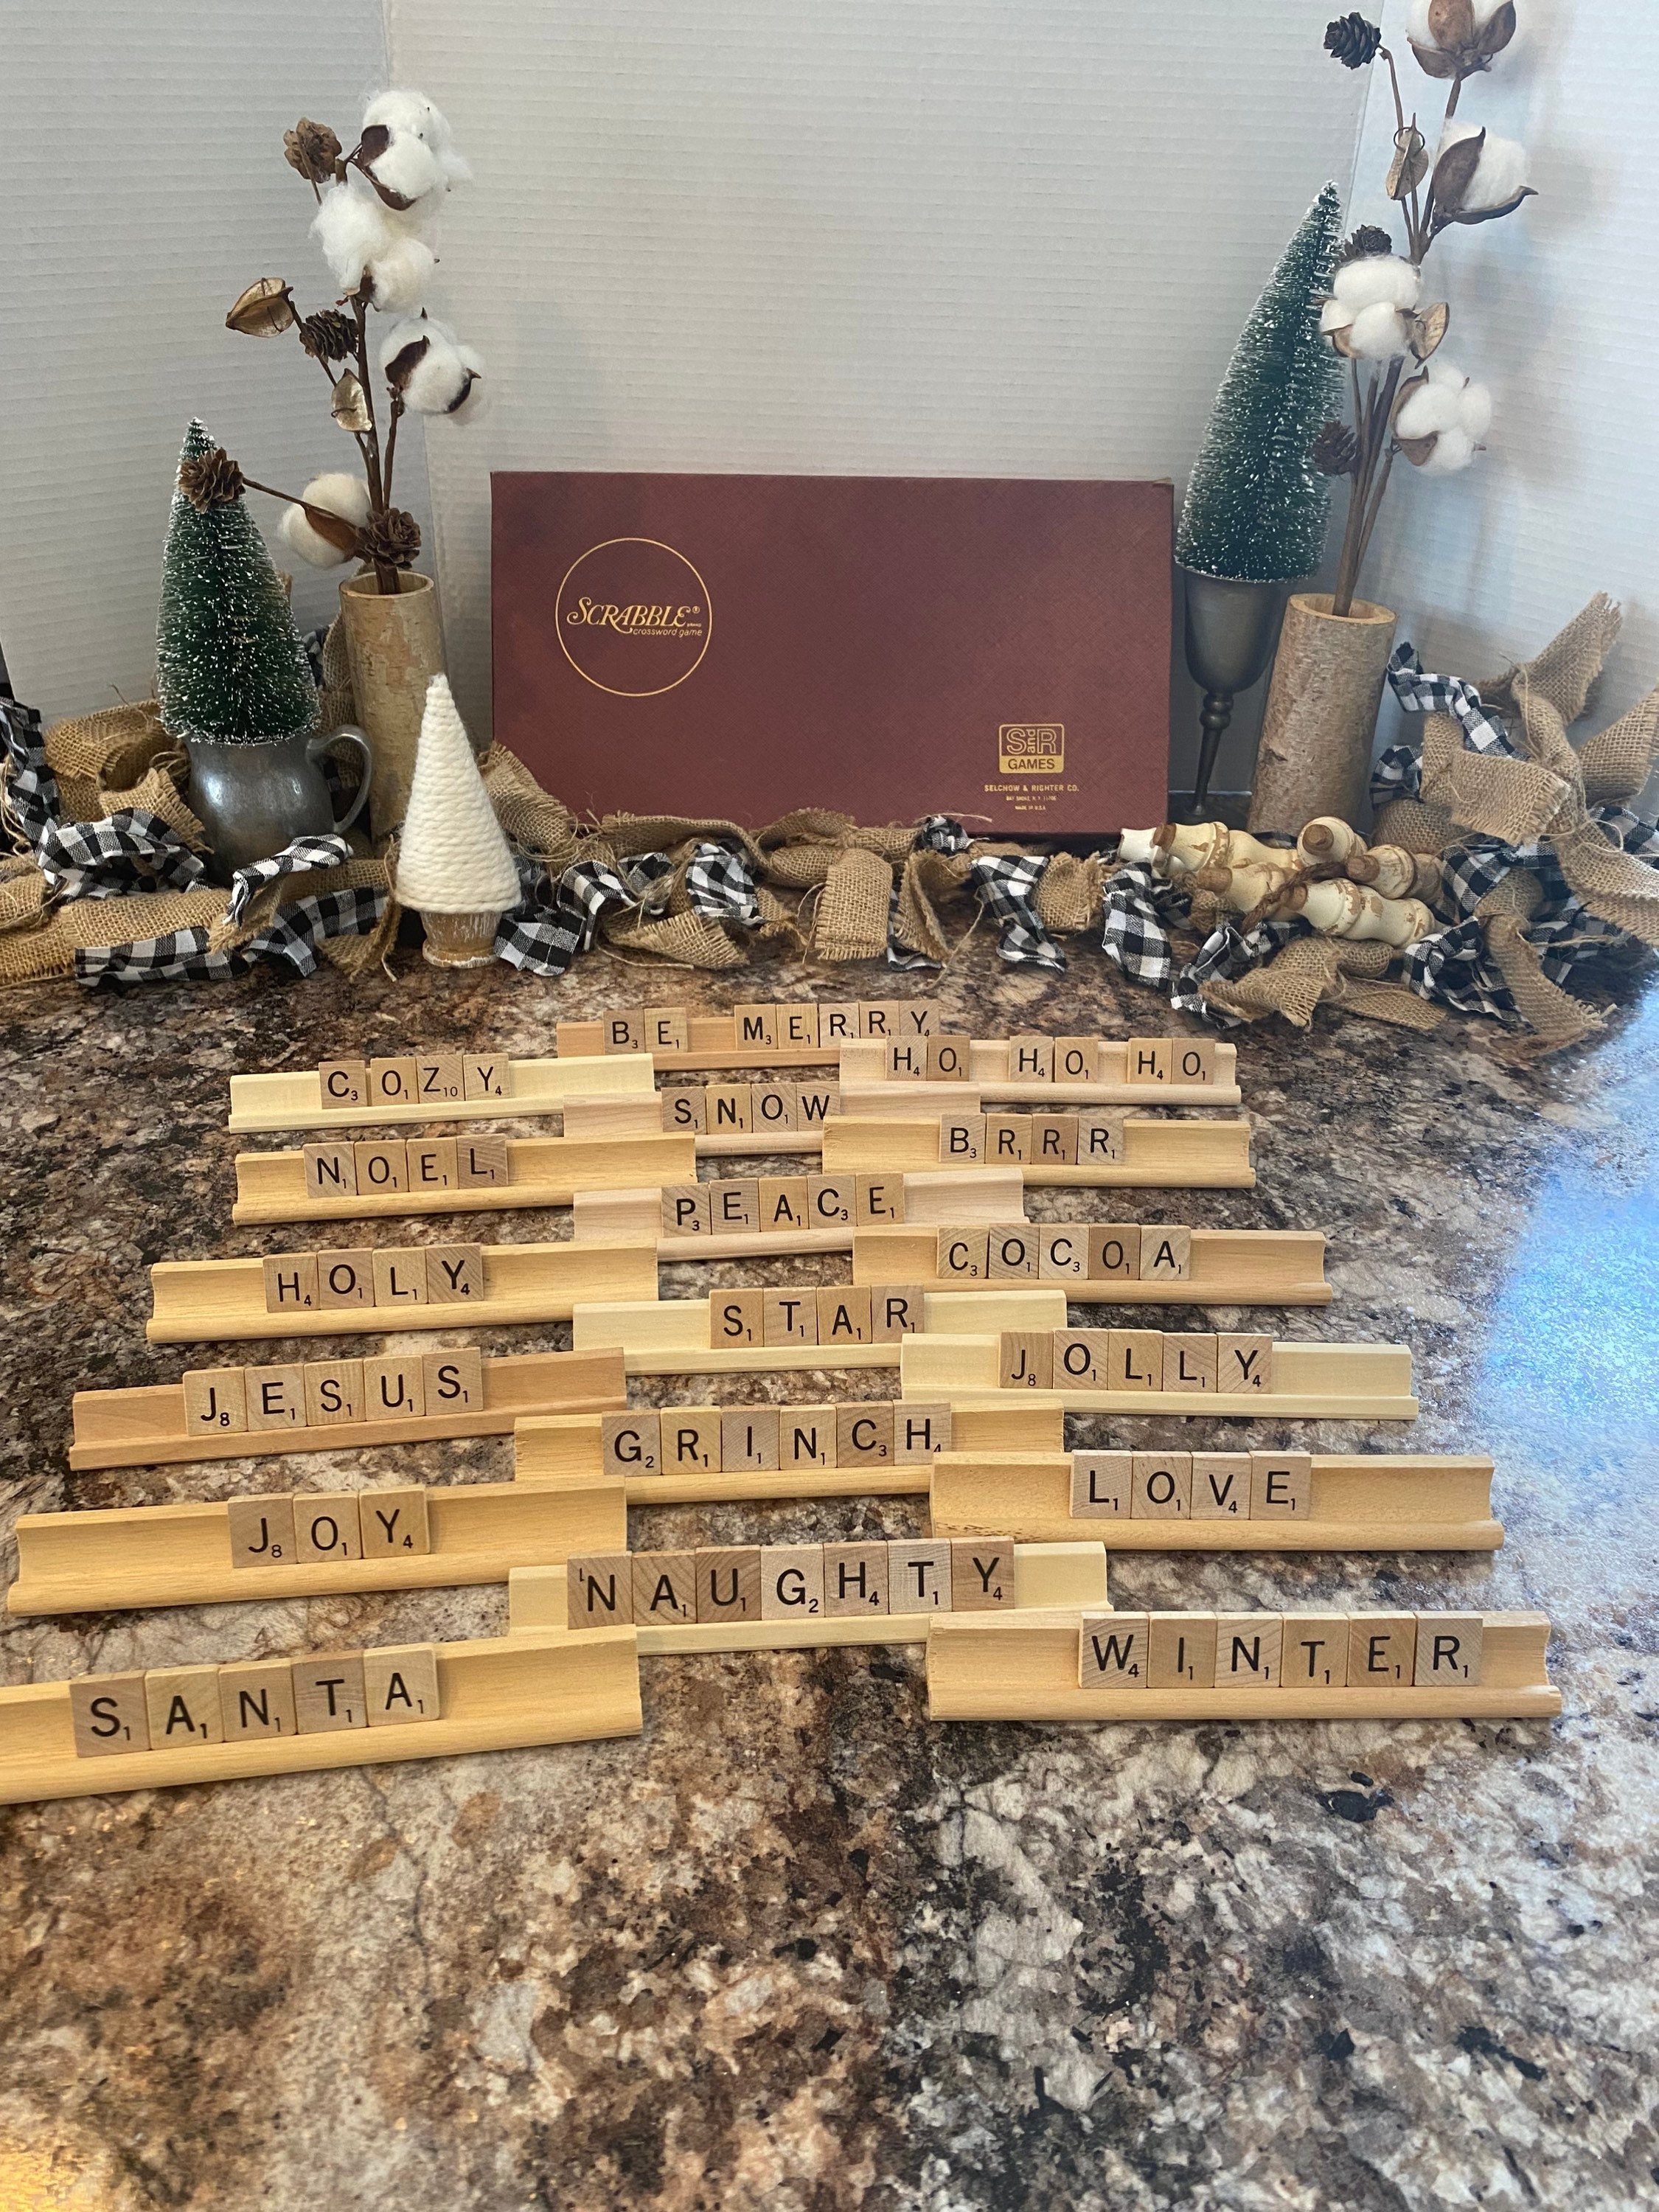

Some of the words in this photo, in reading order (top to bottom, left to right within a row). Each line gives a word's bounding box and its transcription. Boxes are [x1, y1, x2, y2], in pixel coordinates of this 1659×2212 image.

[633, 627, 678, 636] crossword
[678, 629, 703, 638] game
[1008, 758, 1055, 770] GAMES
[612, 1020, 672, 1045] BE
[743, 1010, 928, 1041] MERRY
[893, 1046, 957, 1073] HO
[1018, 1048, 1084, 1075] HO
[1138, 1050, 1201, 1077] HO
[327, 1066, 494, 1098] COZY
[674, 1093, 830, 1124] SNOW
[950, 1127, 1110, 1155] BRRR
[316, 1147, 488, 1185] NOEL
[675, 1186, 886, 1226] PEACE
[948, 1238, 1176, 1271] COCOA
[277, 1259, 465, 1303] HOLY
[723, 1298, 908, 1337] STAR
[1011, 1343, 1259, 1381] JOLLY
[200, 1365, 461, 1422] JESUS
[613, 1418, 931, 1463] GRINCH
[1089, 1470, 1290, 1506] LOVE
[248, 1509, 400, 1554] JOY
[587, 1557, 1000, 1613] NAUGHTY
[1091, 1634, 1461, 1678] WINTER
[90, 1672, 413, 1737] SANTA
